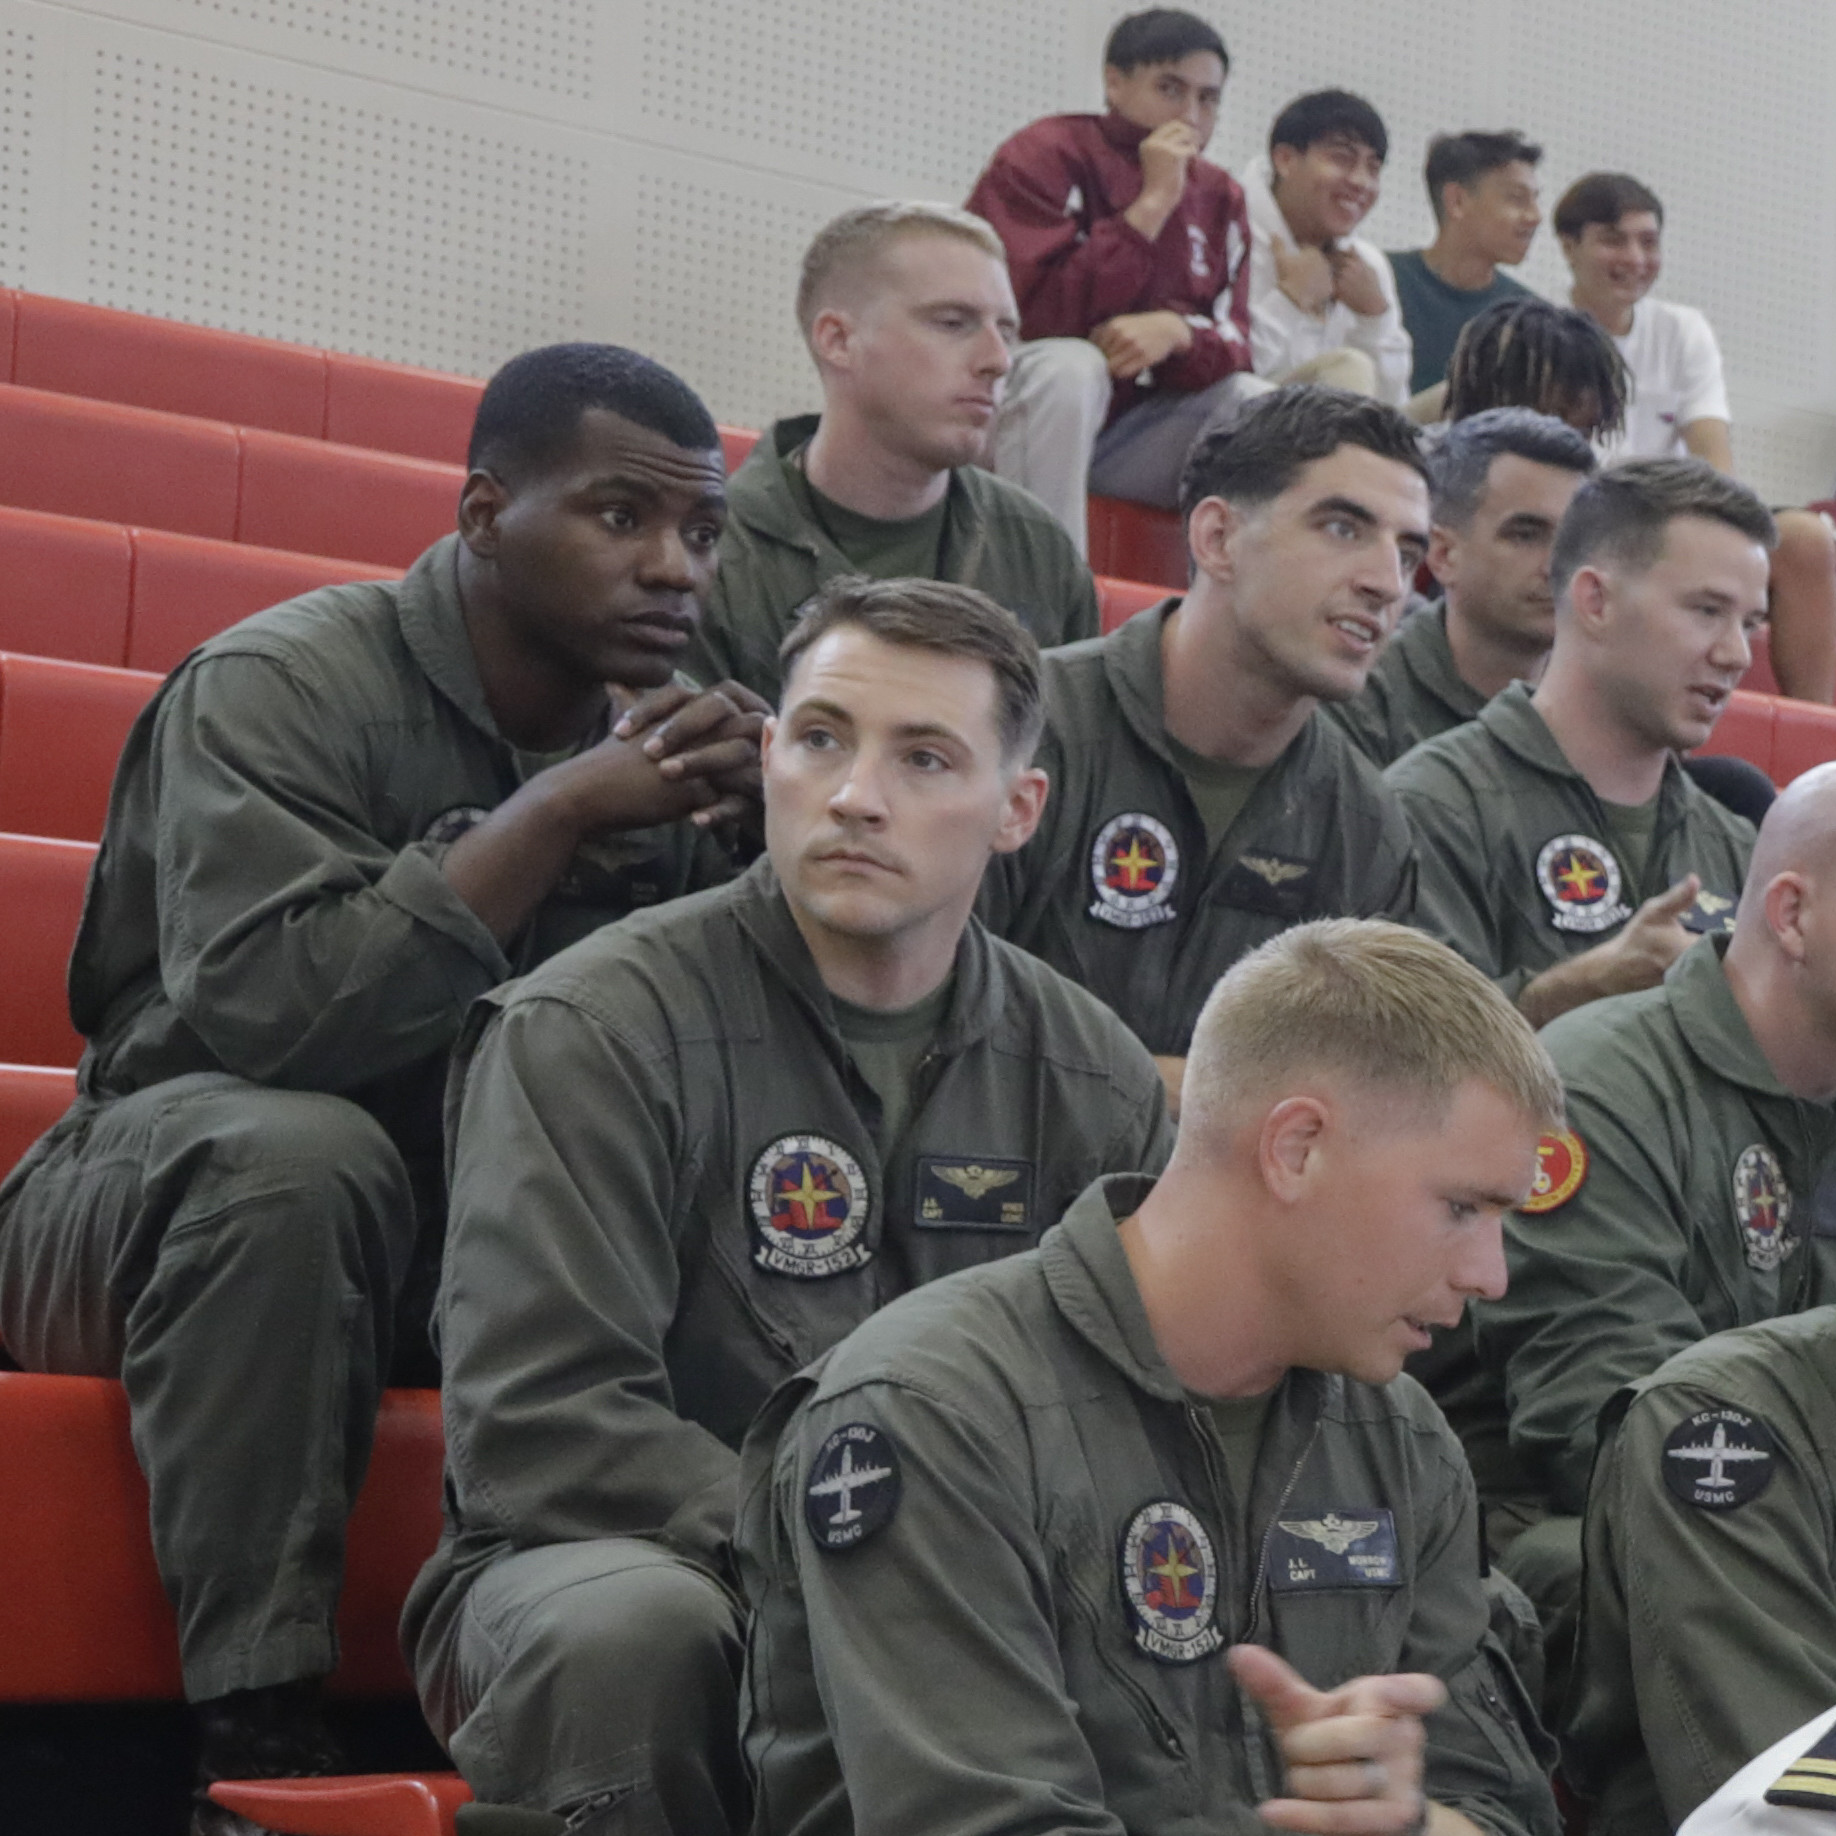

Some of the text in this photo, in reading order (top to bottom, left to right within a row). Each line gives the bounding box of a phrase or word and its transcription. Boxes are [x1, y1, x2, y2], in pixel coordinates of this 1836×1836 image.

[772, 1251, 852, 1275] VMGR-152
[1692, 1410, 1753, 1427] KC-130J
[1694, 1488, 1735, 1503] USMC
[828, 1523, 863, 1544] USMC
[1290, 1569, 1316, 1581] CAPT
[1150, 1634, 1211, 1659] VMGR-152
